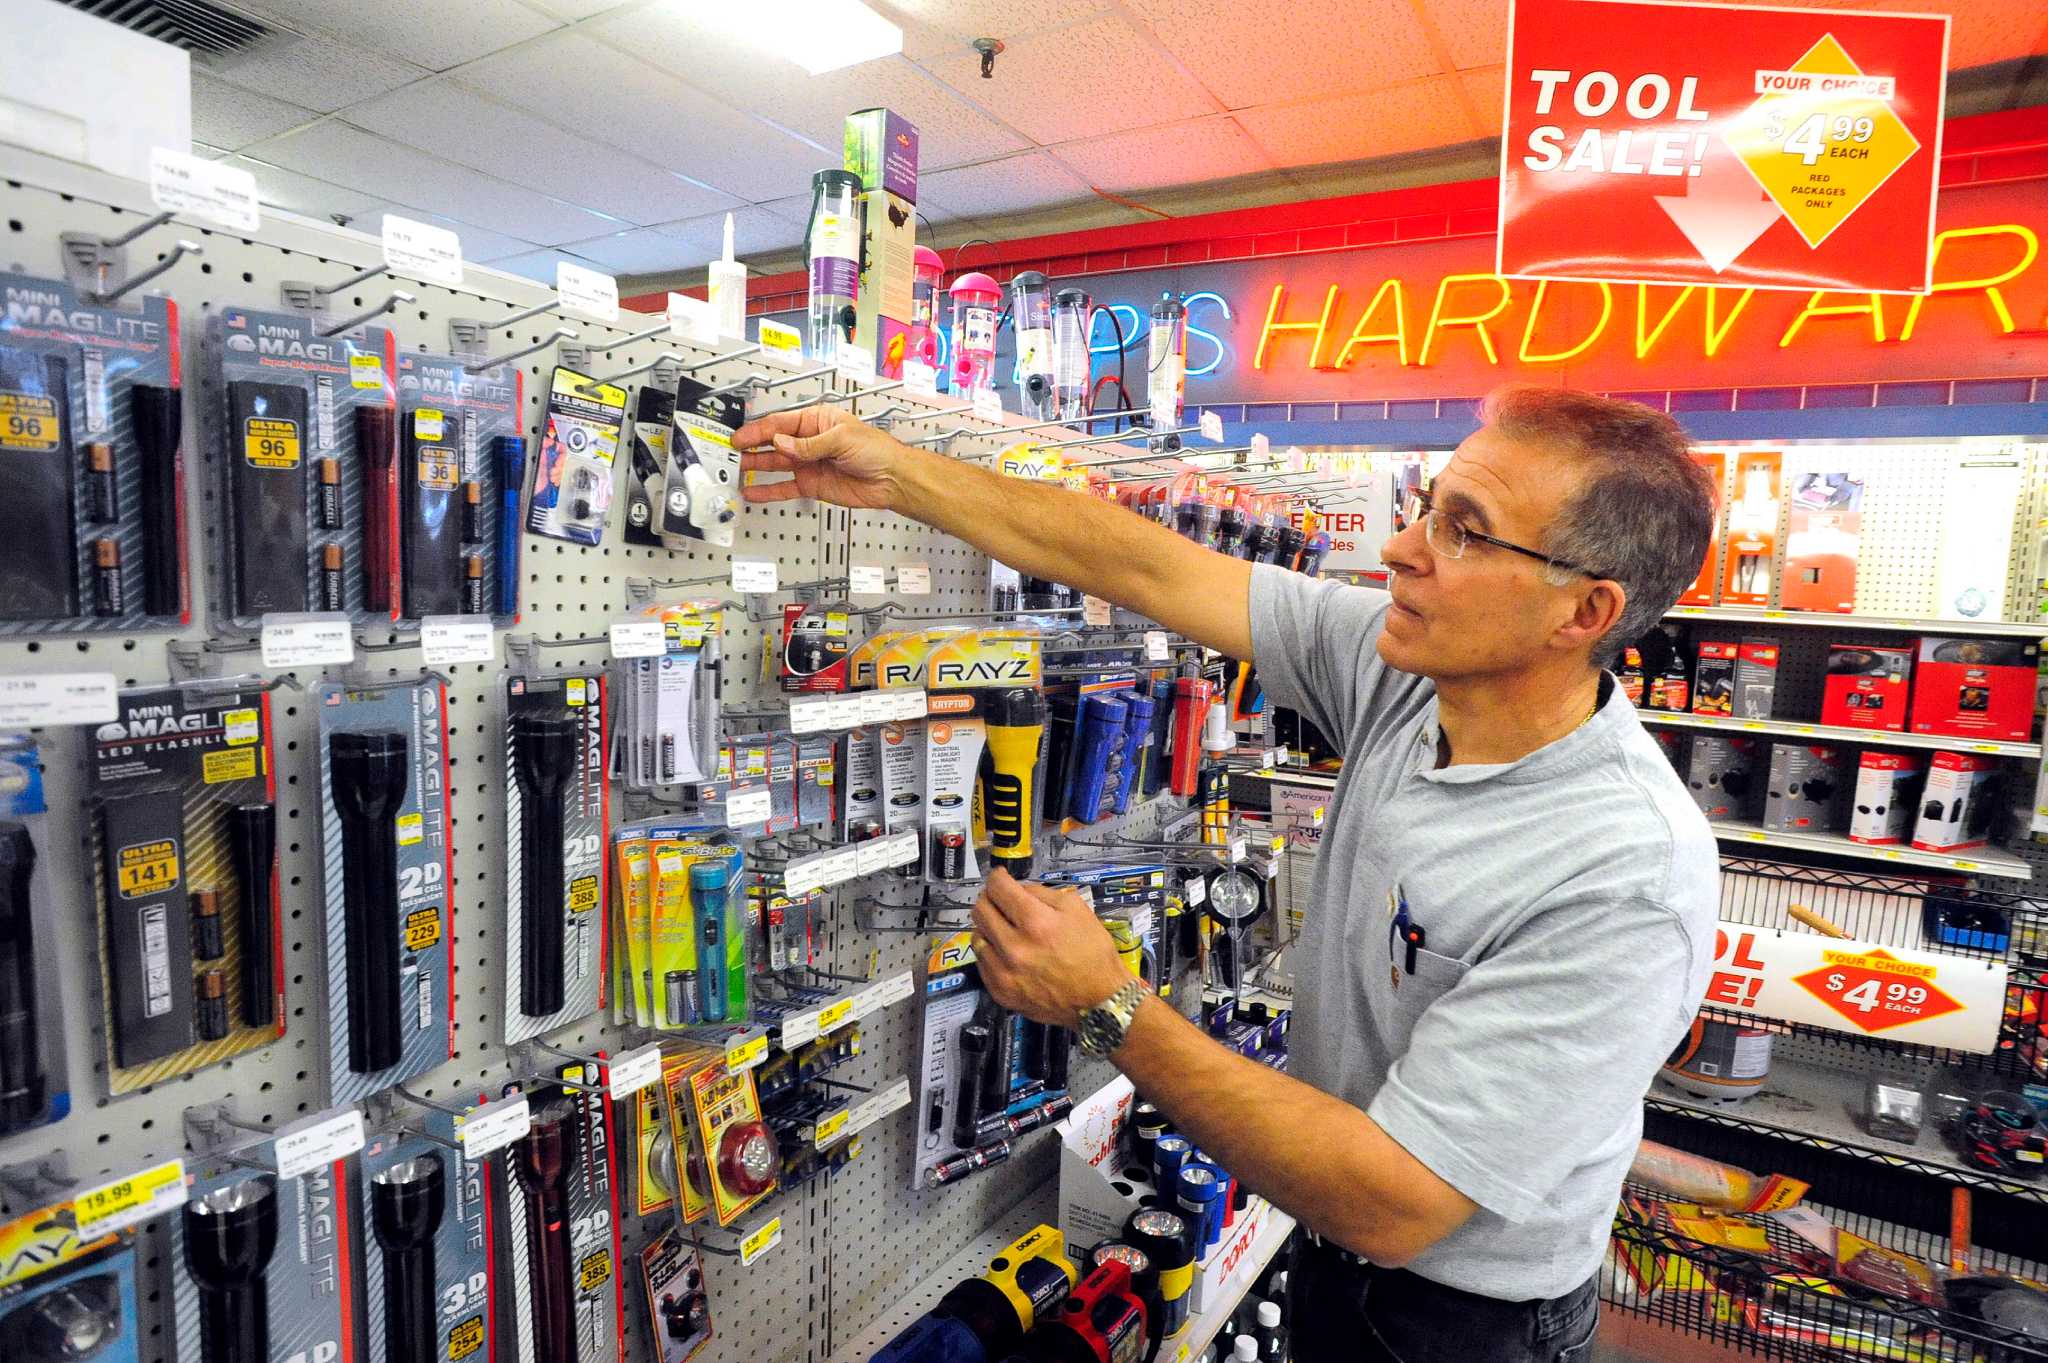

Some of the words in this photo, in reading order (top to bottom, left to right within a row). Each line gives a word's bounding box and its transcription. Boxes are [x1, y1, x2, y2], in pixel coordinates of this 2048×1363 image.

[1531, 69, 1709, 121] TOOL
[1761, 75, 1812, 92] YOUR
[1820, 78, 1890, 96] CHOICE
[1523, 124, 1709, 177] SALE!
[1829, 147, 1871, 160] EACH
[1809, 174, 1831, 184] RED
[1790, 186, 1848, 197] PACKAGES
[1805, 199, 1833, 210] ONLY
[6, 286, 62, 306] MINI
[6, 302, 160, 340] MAGLITE
[257, 324, 301, 341] MINI
[8, 416, 42, 437] 96
[260, 439, 286, 457] 96
[1003, 461, 1045, 477] RAY
[1327, 538, 1355, 551] des
[938, 659, 1032, 682] RAYZ
[128, 704, 174, 719] MINI
[98, 747, 133, 759] LED
[588, 705, 602, 817] MAGLITE
[421, 718, 443, 849] MAGLITE
[577, 738, 585, 819] FLASHLIGHT
[129, 862, 169, 884] 141
[573, 890, 594, 905] 388
[411, 924, 435, 942] 229
[942, 944, 978, 965] RA
[1826, 953, 1866, 966] YOUR
[1875, 959, 1932, 977] CHOICE
[1887, 983, 1928, 1005] 99
[1884, 1002, 1921, 1015] EACH
[588, 1089, 608, 1194] MAGLITE
[85, 1181, 133, 1211] 19.99
[464, 1162, 483, 1254] AGLITE
[585, 1263, 607, 1283] 388
[453, 1331, 479, 1353] 254
